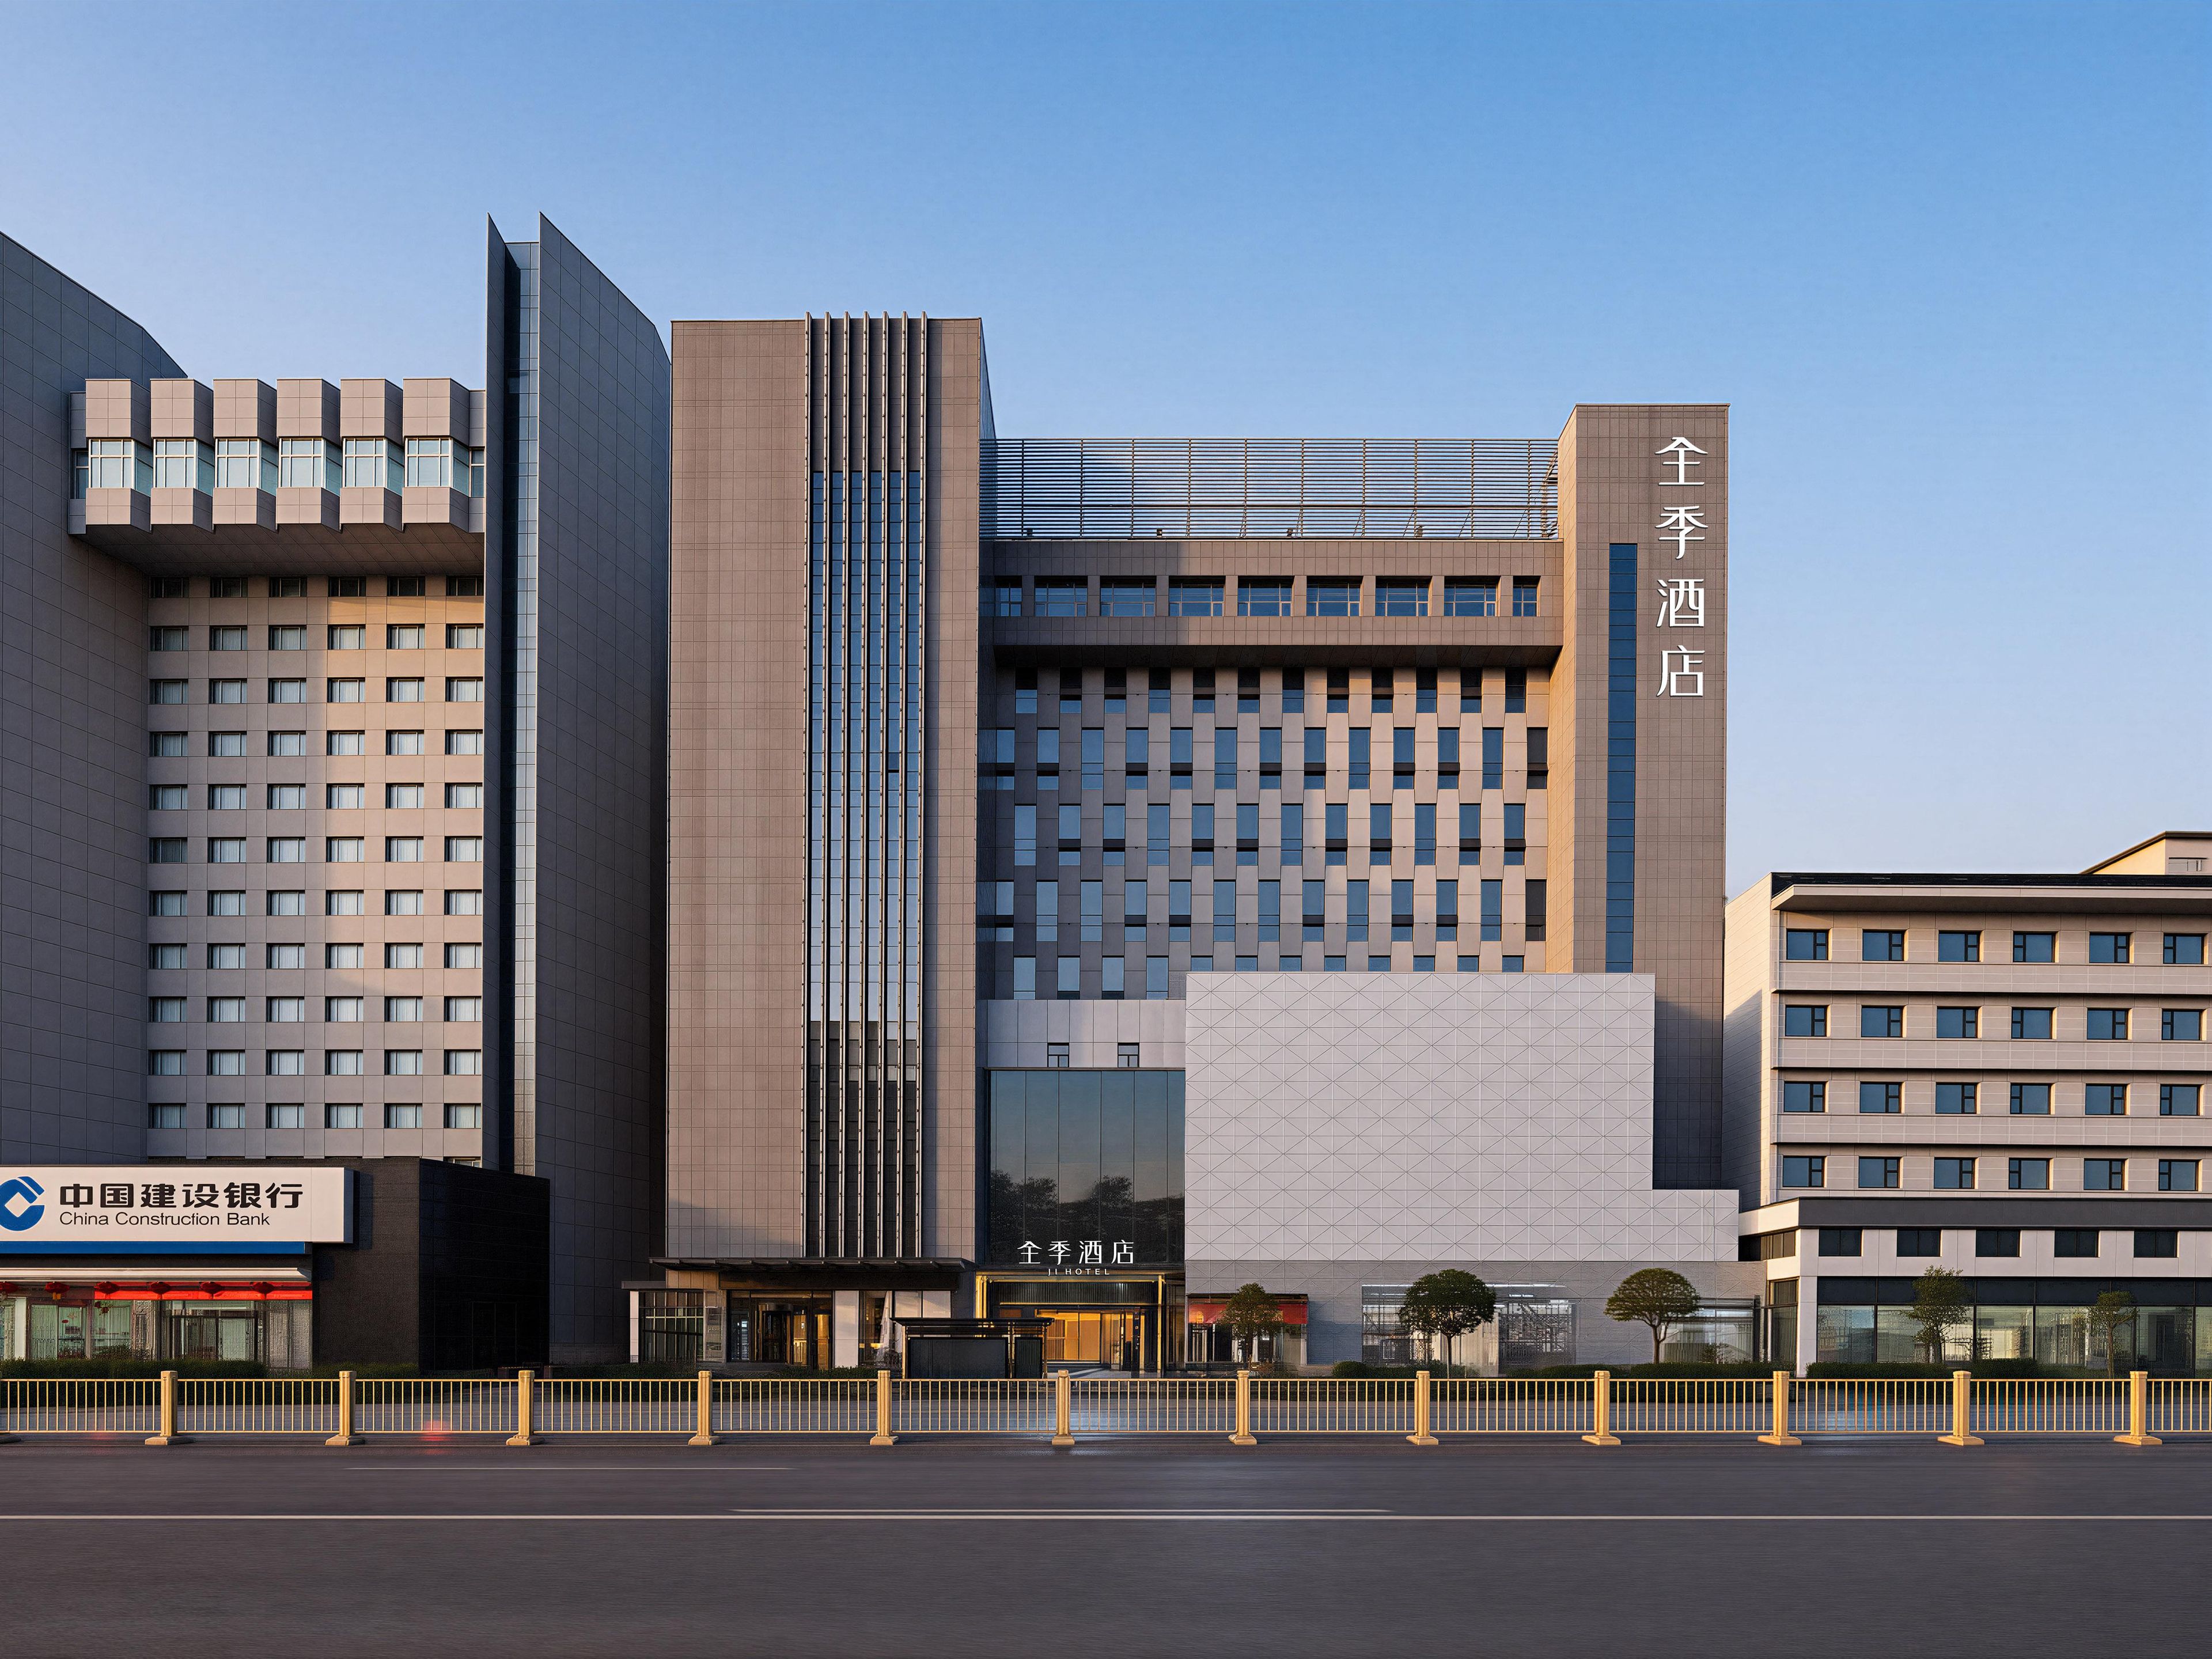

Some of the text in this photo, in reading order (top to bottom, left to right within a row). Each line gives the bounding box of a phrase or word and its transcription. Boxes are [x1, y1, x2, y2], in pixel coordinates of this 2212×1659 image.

[1654, 437, 1709, 697] 全季酒店
[59, 1182, 304, 1209] 中国建设银行
[59, 1211, 270, 1226] China Construction Bank
[1017, 1239, 1134, 1265] 全季酒店
[1048, 1268, 1110, 1277] JI HOTEL
